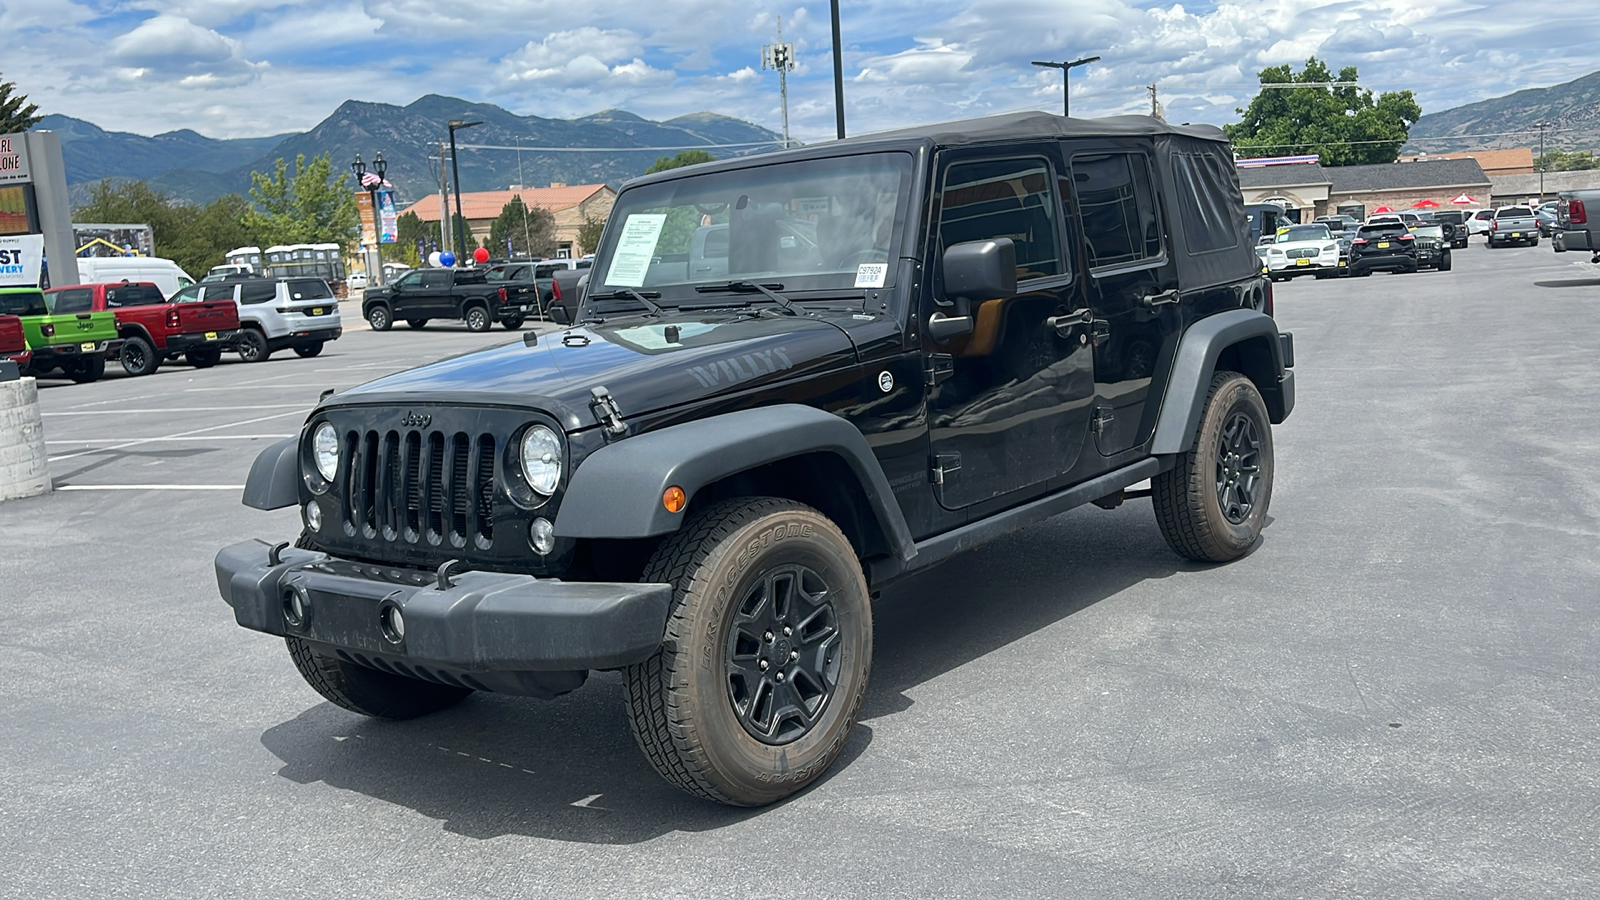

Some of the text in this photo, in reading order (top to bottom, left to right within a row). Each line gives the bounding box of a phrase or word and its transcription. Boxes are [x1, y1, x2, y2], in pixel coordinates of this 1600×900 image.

[0, 155, 20, 170] ONE
[859, 266, 882, 275] C9792A
[685, 346, 793, 388] WILLYS
[401, 410, 432, 430] Jeep
[700, 522, 813, 670] BRIDGESTONE
